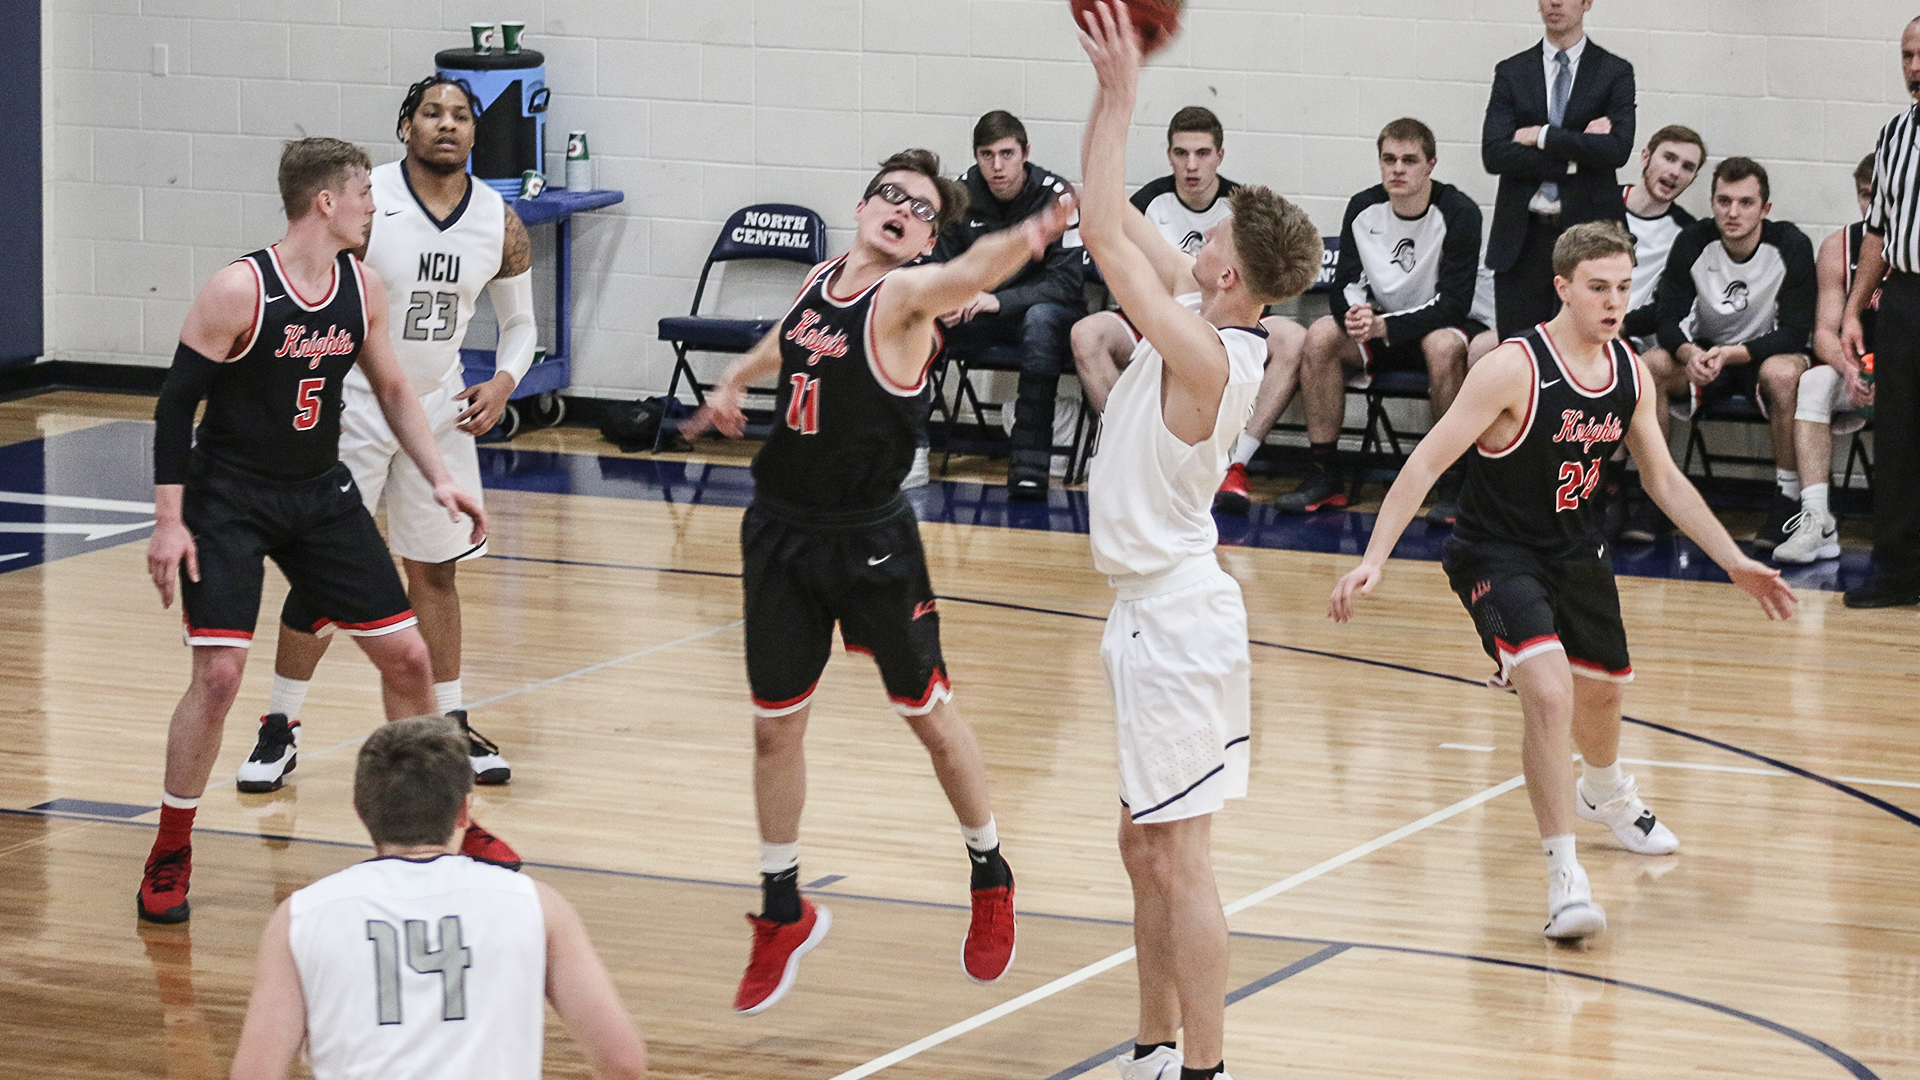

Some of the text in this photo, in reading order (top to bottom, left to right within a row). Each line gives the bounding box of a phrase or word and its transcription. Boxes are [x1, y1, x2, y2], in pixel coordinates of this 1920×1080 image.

[731, 226, 810, 249] CENTRAL
[743, 211, 808, 231] NORTH
[417, 252, 460, 283] NCU
[403, 291, 459, 341] 23
[275, 323, 355, 370] Knights
[292, 377, 326, 431] 5
[786, 372, 821, 435] 11
[1552, 409, 1623, 454] Knights
[365, 914, 472, 1026] 14
